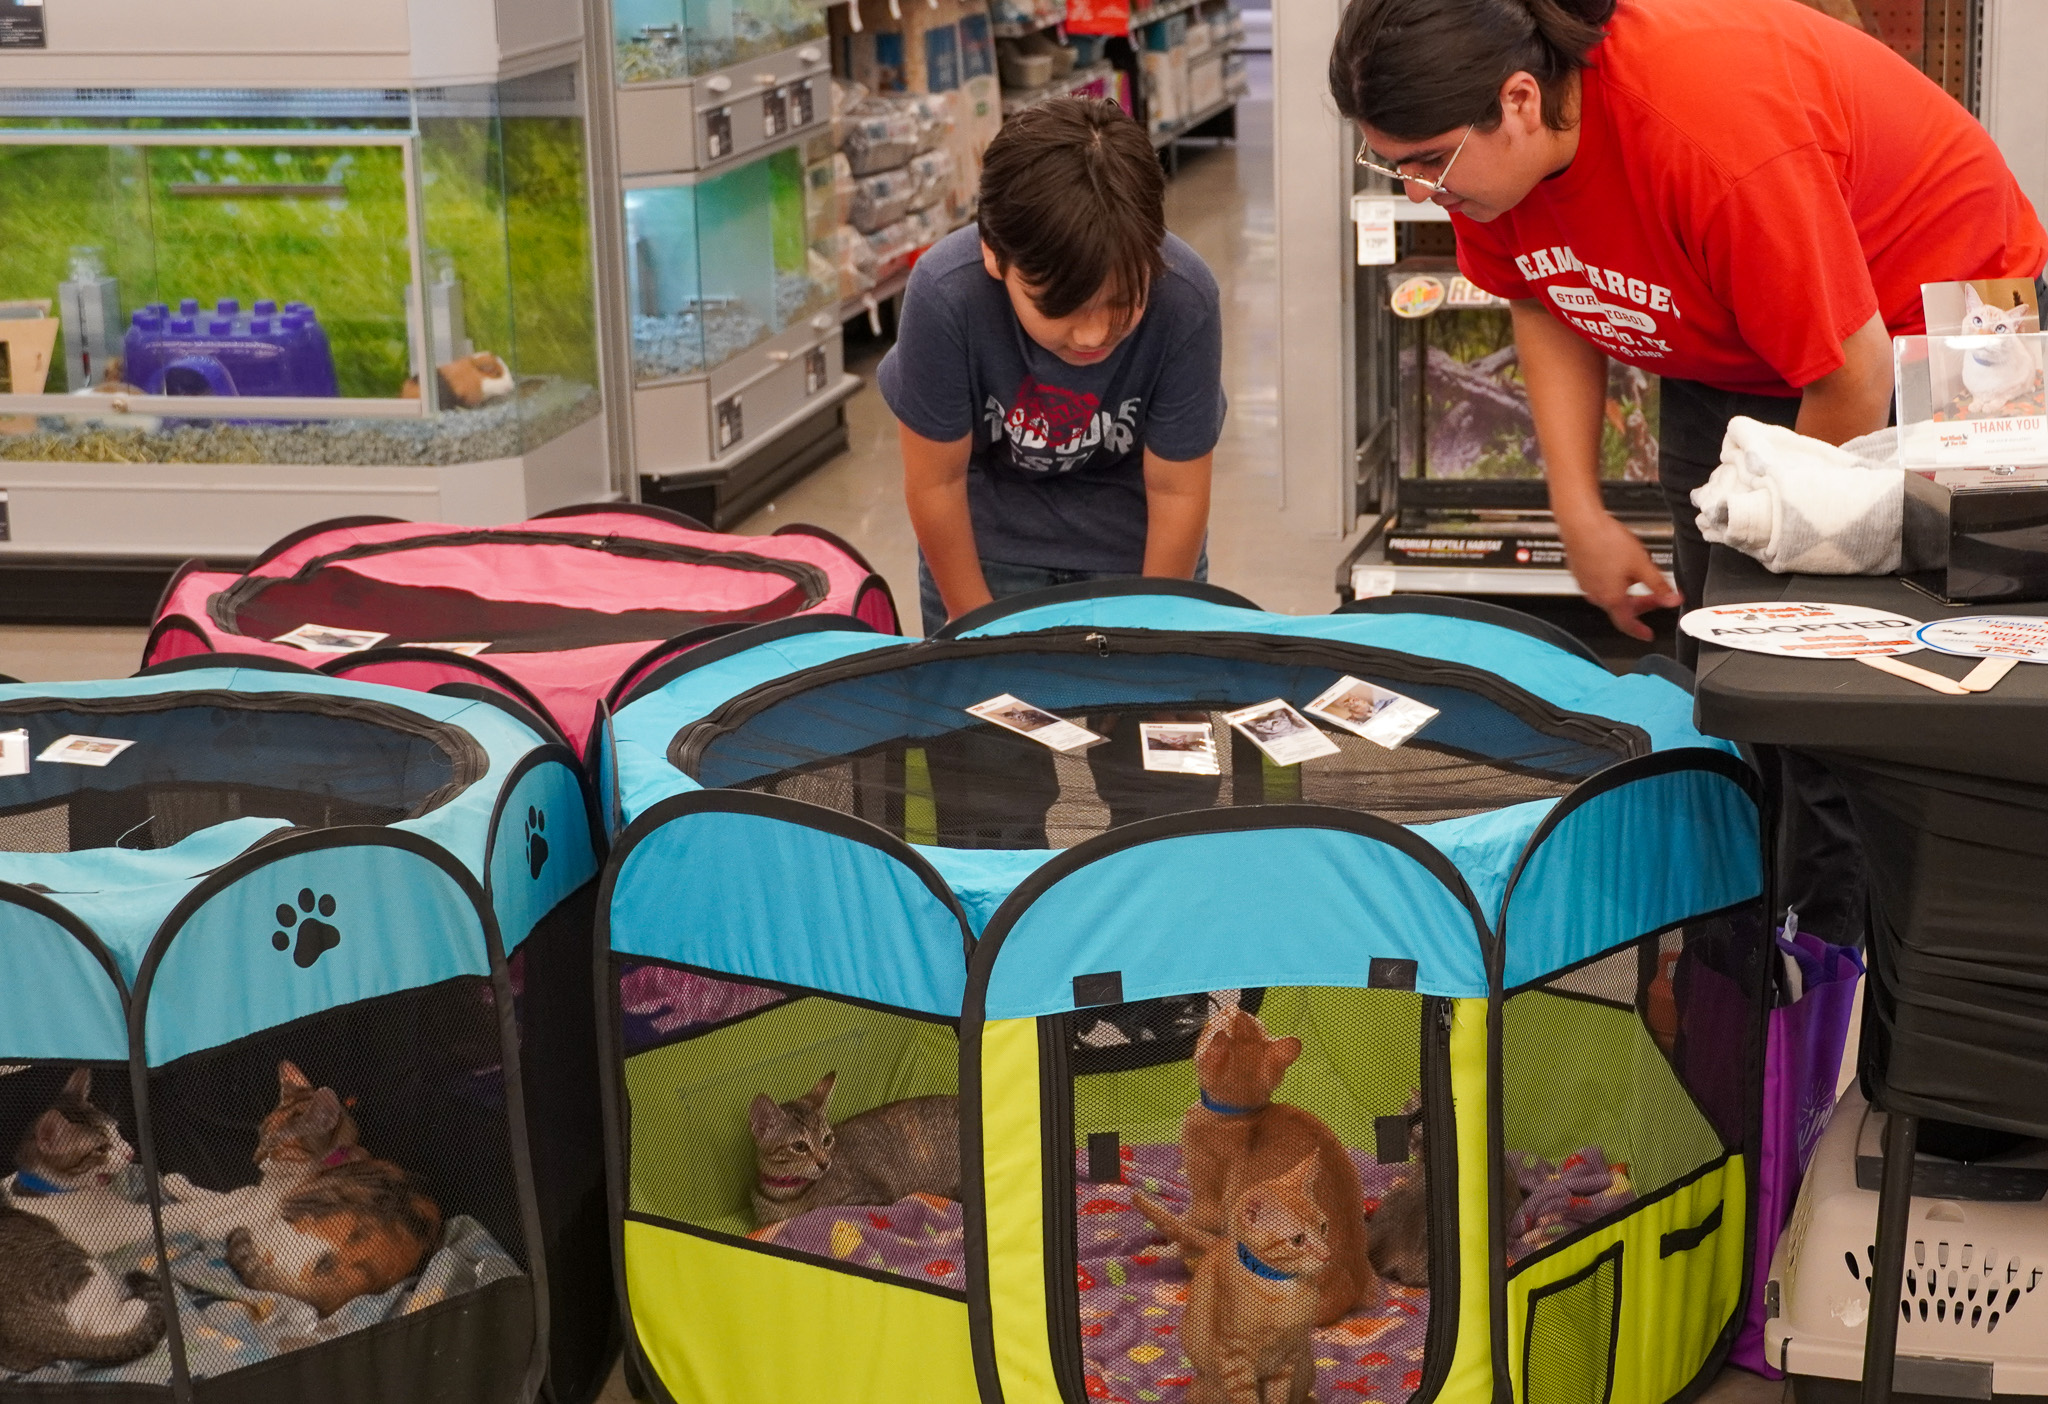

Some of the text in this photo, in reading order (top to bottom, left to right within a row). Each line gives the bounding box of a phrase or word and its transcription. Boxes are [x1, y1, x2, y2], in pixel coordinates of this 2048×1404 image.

[1515, 246, 1681, 319] EAM ARGE
[1556, 292, 1600, 306] STOR
[1562, 310, 1641, 347] LAREO,
[1971, 418, 2040, 434] THANK YOU
[1389, 538, 1431, 550] PREMIUM
[1431, 539, 1466, 551] REPTILE
[1710, 619, 1913, 636] ADOPTED
[1977, 630, 2048, 640] ADOPTI
[1989, 624, 2048, 633] NATIO
